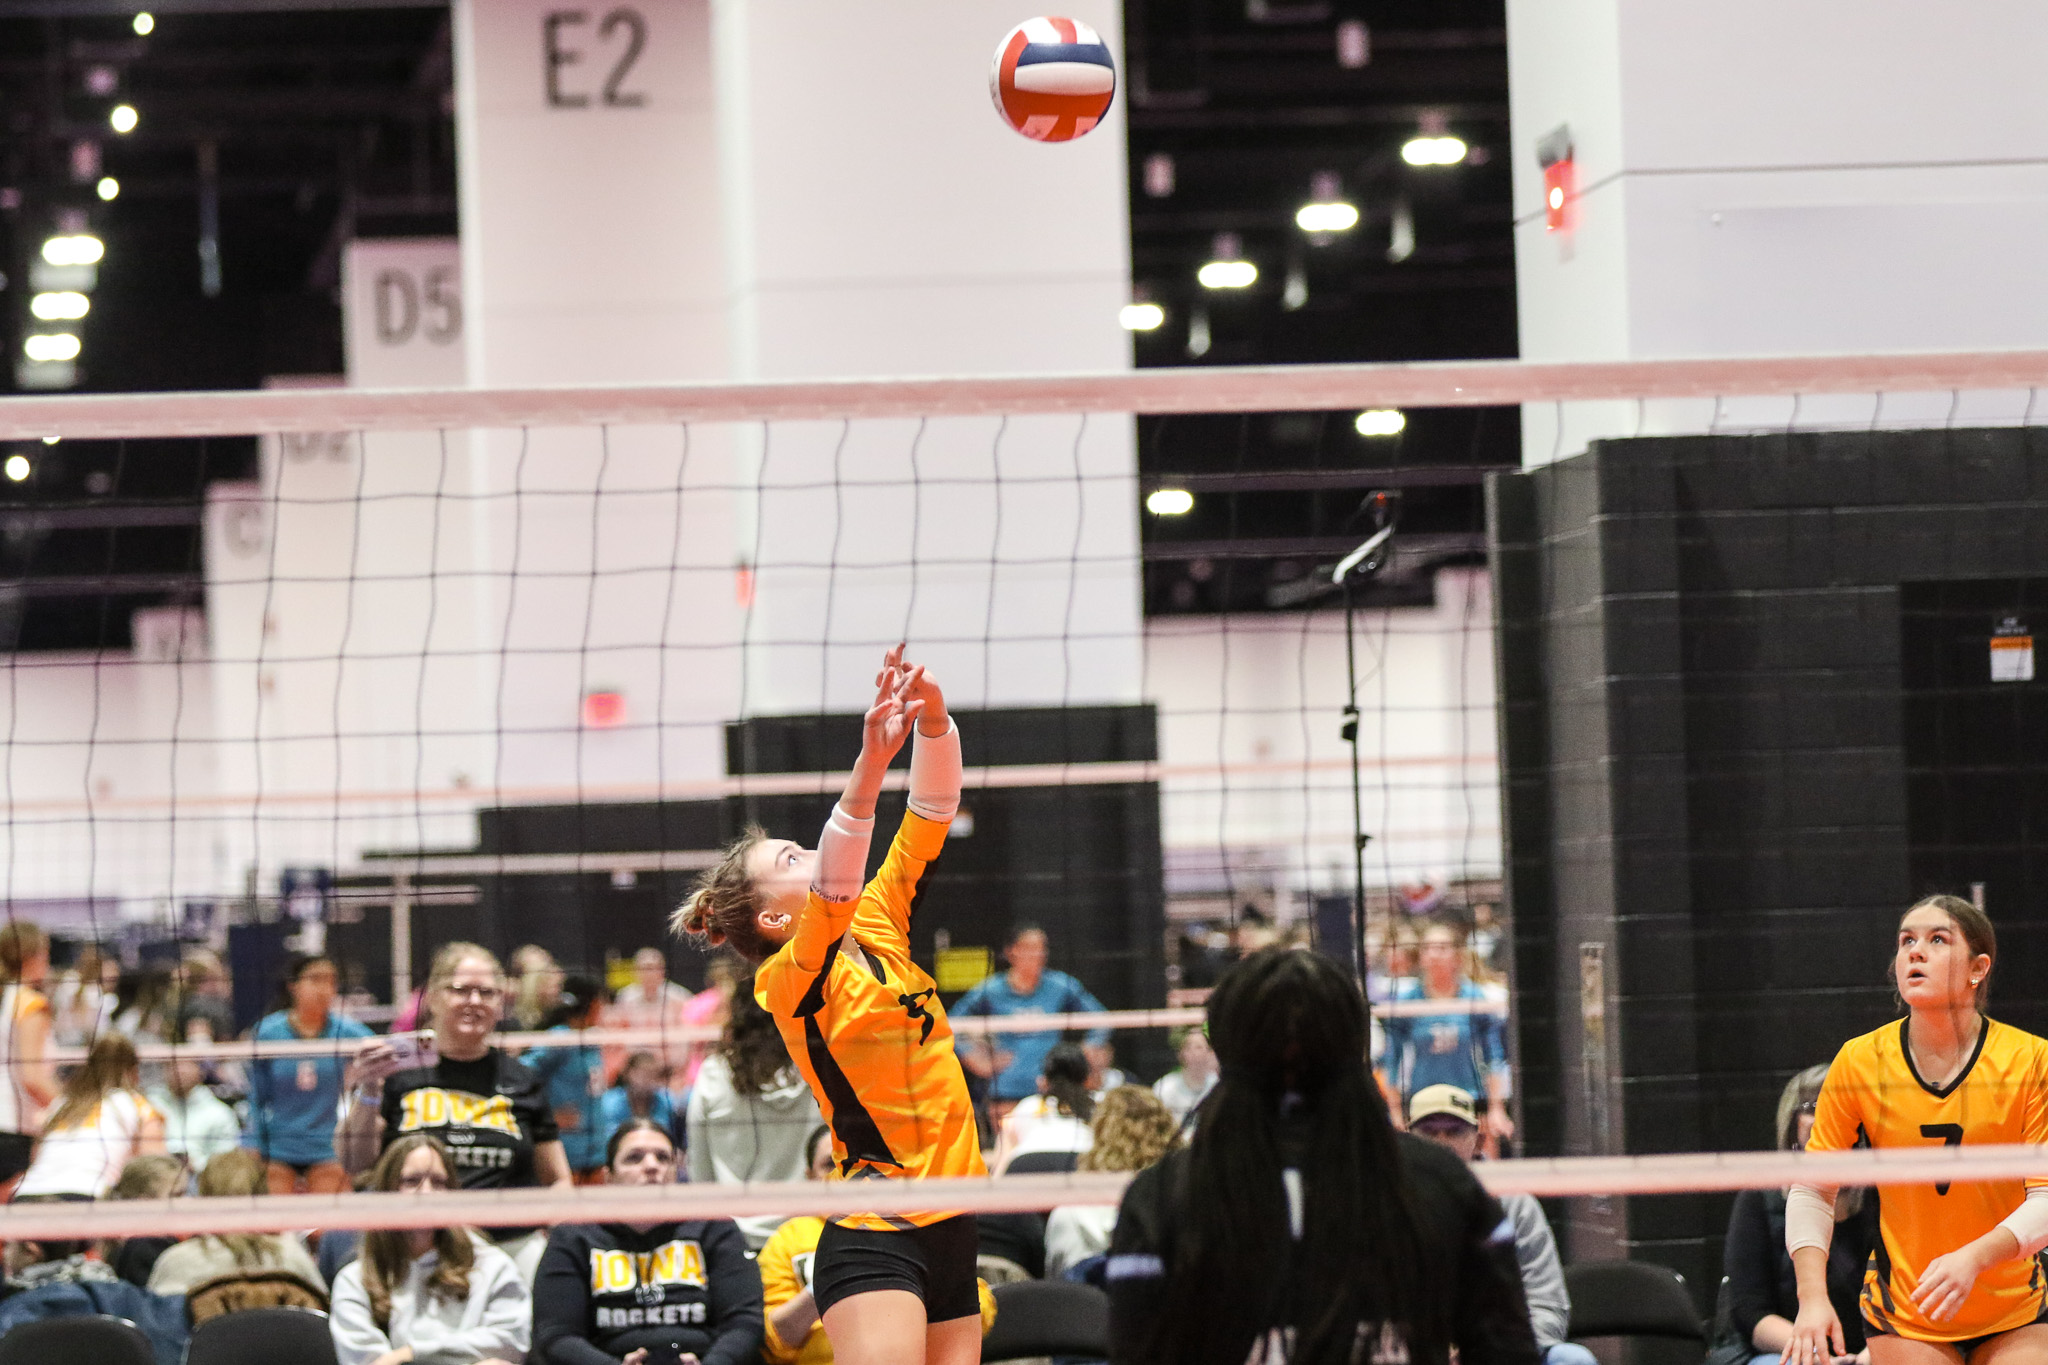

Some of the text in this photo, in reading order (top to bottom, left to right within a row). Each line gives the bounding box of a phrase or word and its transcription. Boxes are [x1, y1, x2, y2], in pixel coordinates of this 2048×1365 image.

[544, 7, 651, 108] E2
[374, 266, 463, 346] D5
[399, 1086, 523, 1140] IOWA
[1919, 1123, 1964, 1196] 7
[590, 1239, 709, 1297] IOWA
[596, 1302, 706, 1328] ROCKETS
